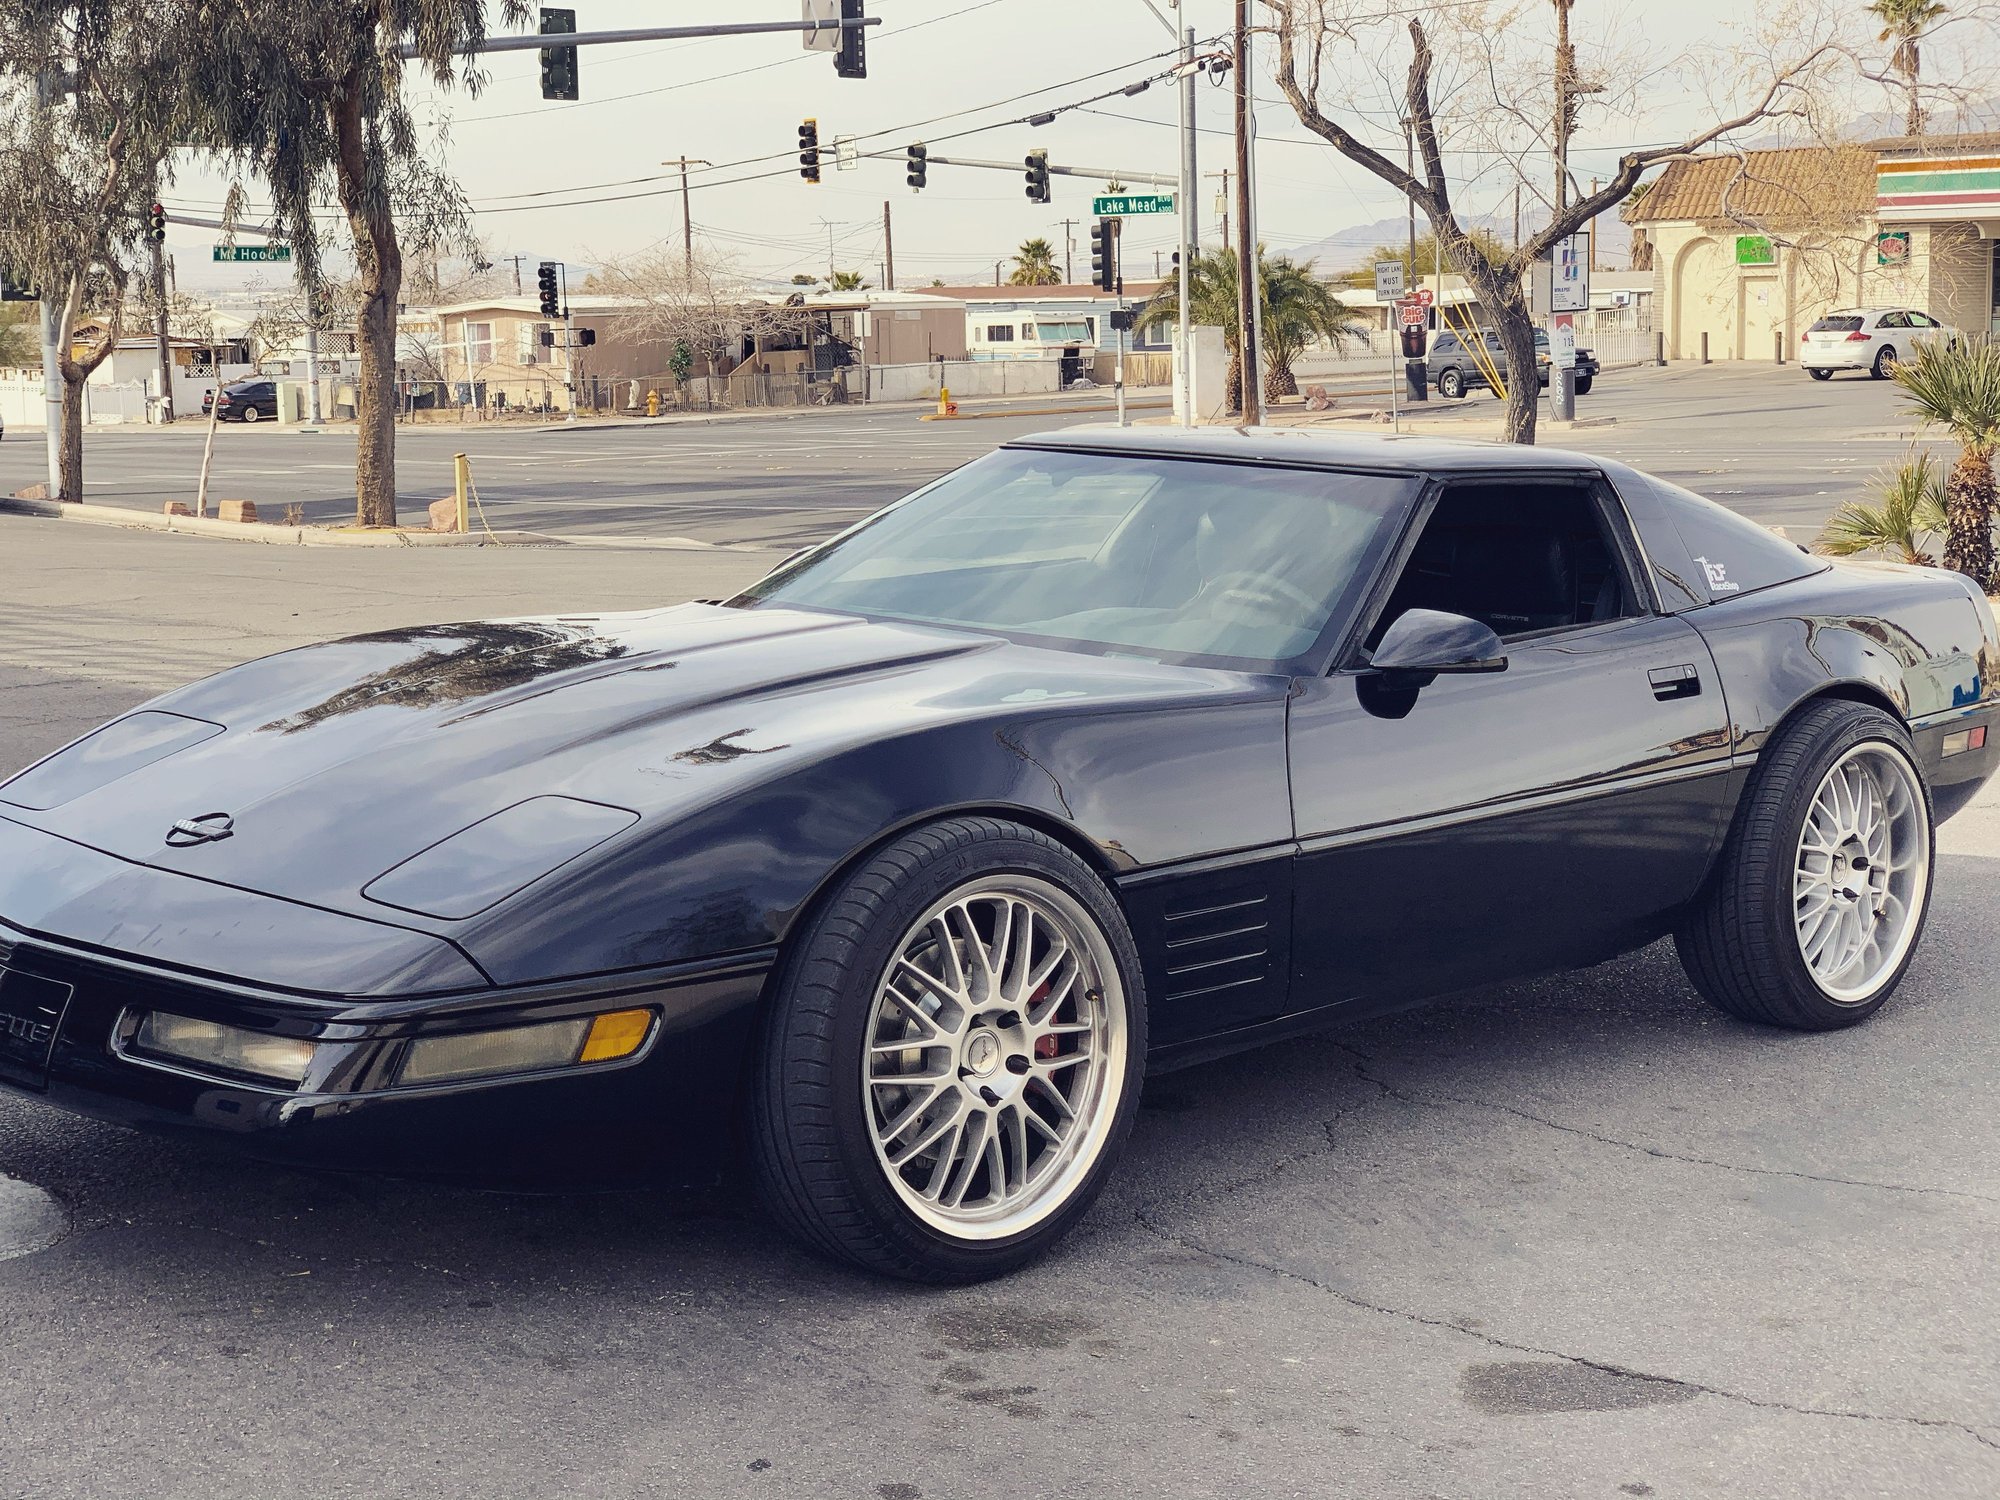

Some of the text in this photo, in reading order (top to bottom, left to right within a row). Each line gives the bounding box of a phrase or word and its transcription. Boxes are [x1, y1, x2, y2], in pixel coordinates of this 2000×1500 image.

[1099, 199, 1124, 214] Lake
[1128, 198, 1157, 212] Mead
[1158, 195, 1171, 203] BLVD
[1382, 276, 1398, 285] MUST
[1402, 315, 1425, 324] GULP
